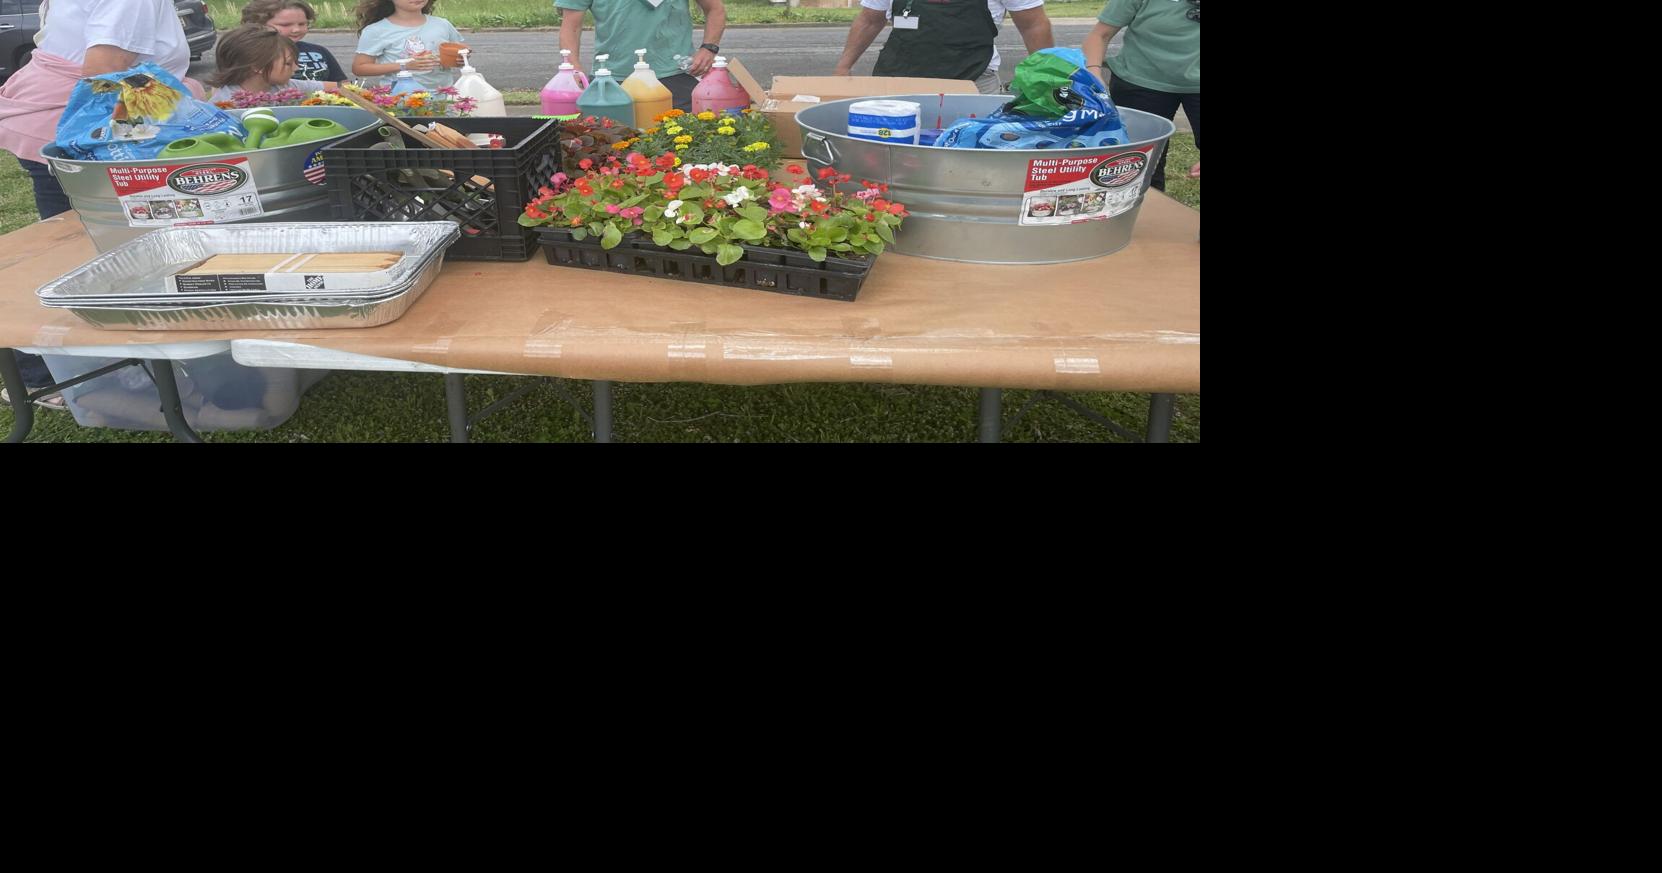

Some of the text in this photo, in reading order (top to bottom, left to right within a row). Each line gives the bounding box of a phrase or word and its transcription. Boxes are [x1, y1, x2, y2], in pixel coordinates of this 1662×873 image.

[1033, 158, 1098, 166] Multi-Purpose
[110, 167, 167, 175] Multi-Purpose
[1098, 160, 1144, 177] BEHRENS
[175, 171, 240, 185] BEHRENS
[240, 195, 252, 203] 17
